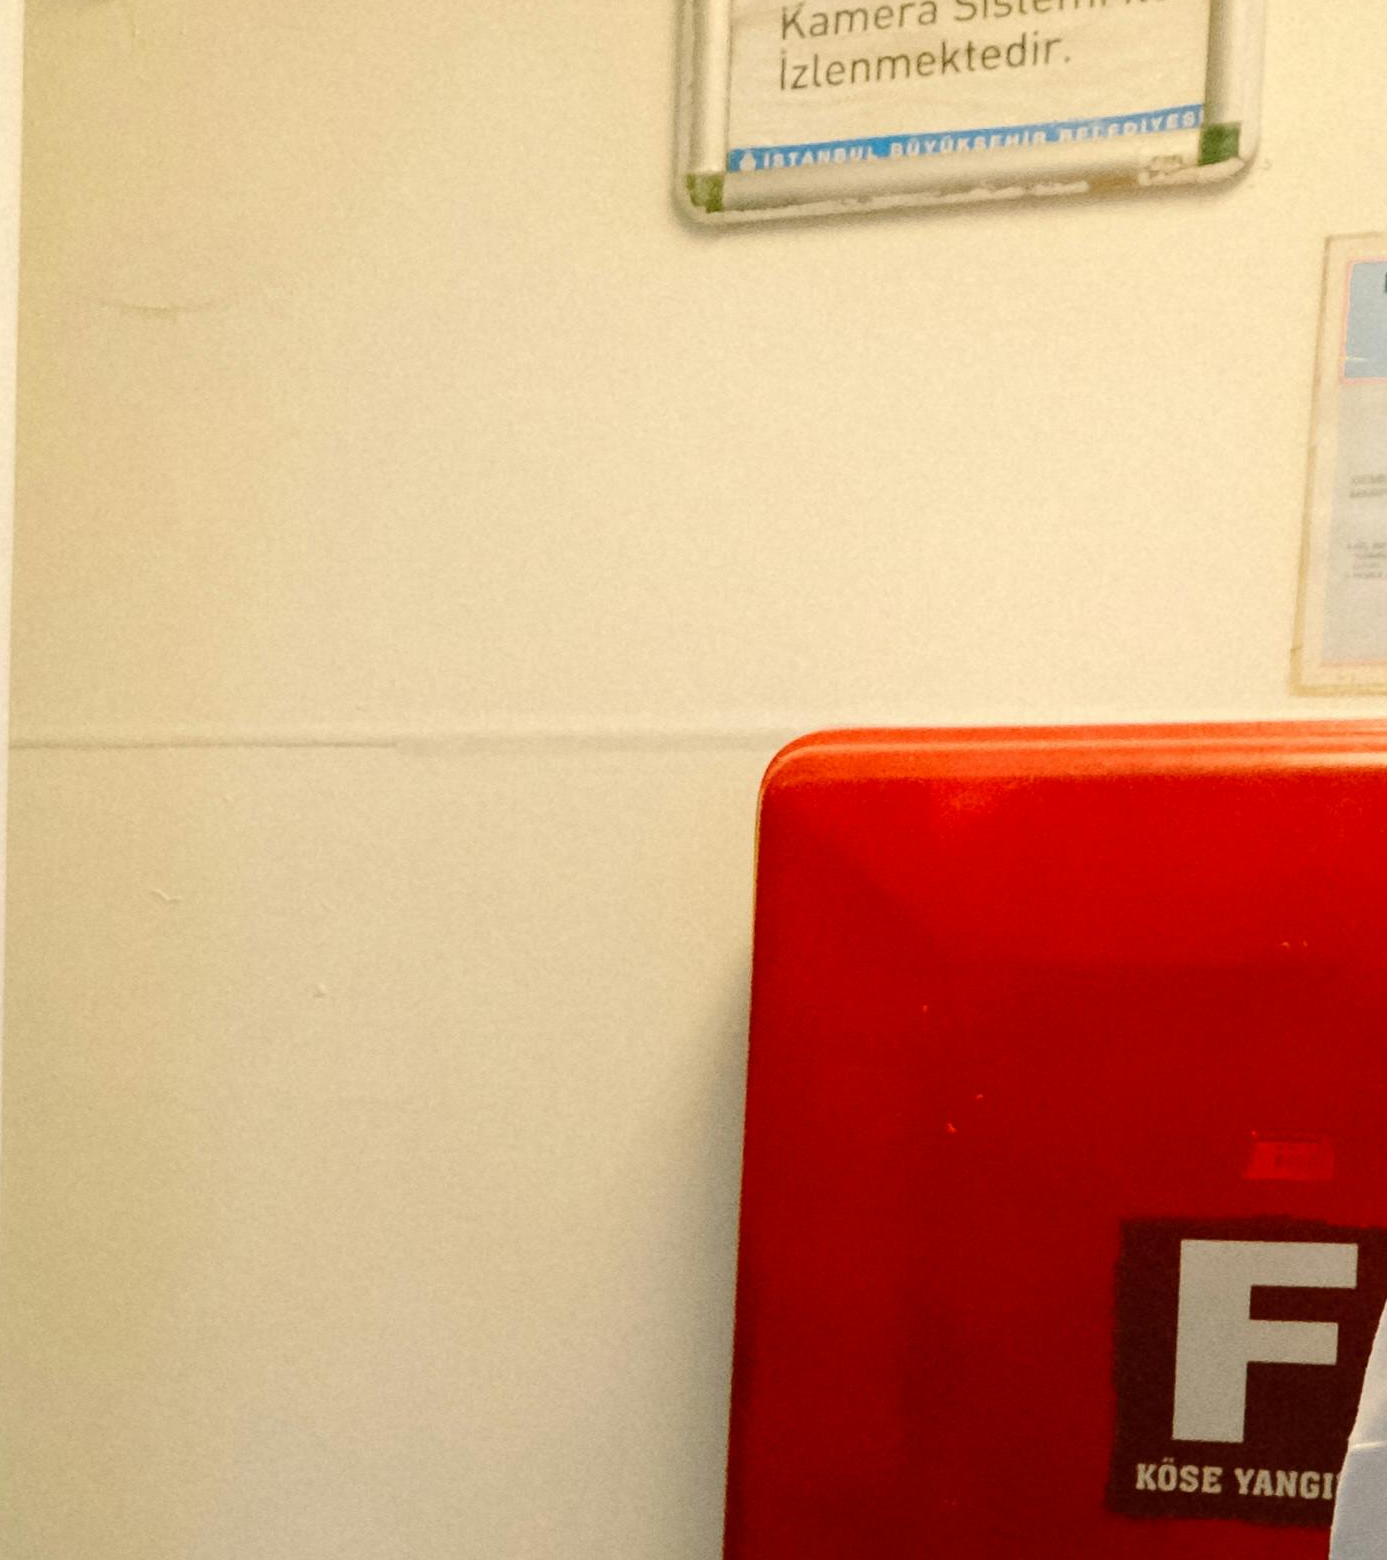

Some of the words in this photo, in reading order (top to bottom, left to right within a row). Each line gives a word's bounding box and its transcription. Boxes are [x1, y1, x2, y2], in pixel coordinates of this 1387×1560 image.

[781, 0, 938, 41] Kamera
[779, 29, 1072, 91] İzlenmektedir.
[1172, 1239, 1359, 1443] F
[1135, 1457, 1223, 1494] KÖSE
[1234, 1467, 1339, 1500] YANGI
